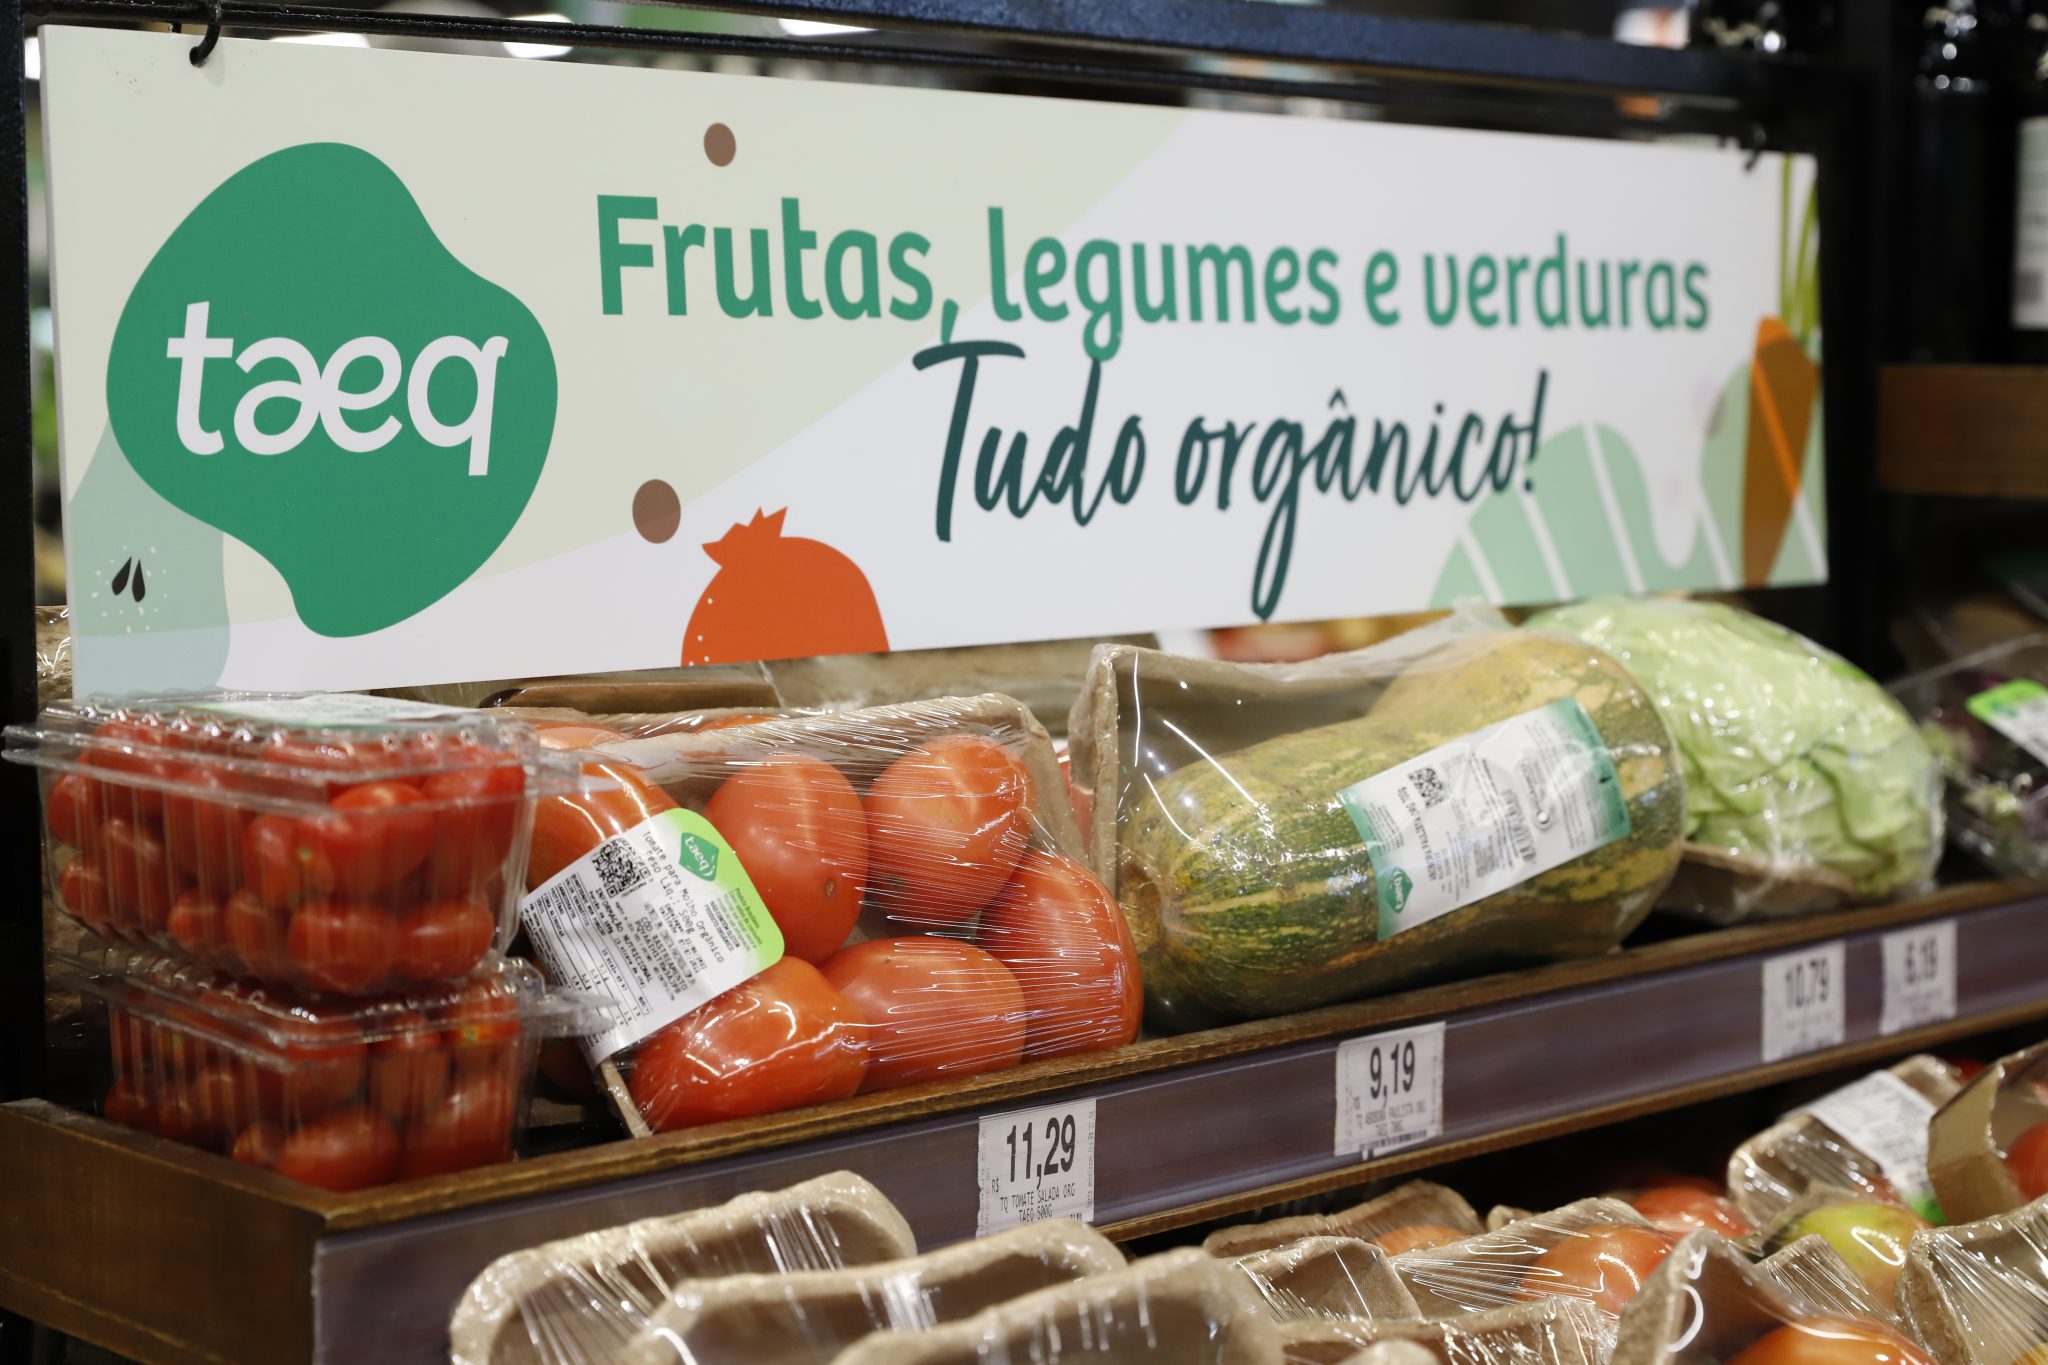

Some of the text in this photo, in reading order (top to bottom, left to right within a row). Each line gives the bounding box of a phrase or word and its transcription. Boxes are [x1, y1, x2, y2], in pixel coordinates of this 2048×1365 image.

[599, 196, 1709, 362] Frutas, legumes e verduras
[167, 301, 509, 476] taeq
[912, 340, 1548, 622] Tudo orgânico!
[684, 836, 711, 871] taeq
[595, 887, 624, 932] INFORMAÇÃO
[621, 934, 653, 983] NUTRICIONAL
[642, 831, 724, 964] Tomate para Molho Orgânico
[1370, 1040, 1416, 1110] 9,19
[992, 1178, 999, 1193] R$
[1006, 1114, 1076, 1190] 11,29
[1011, 1191, 1034, 1209] TOMATE
[1037, 1185, 1060, 1204] SALADA
